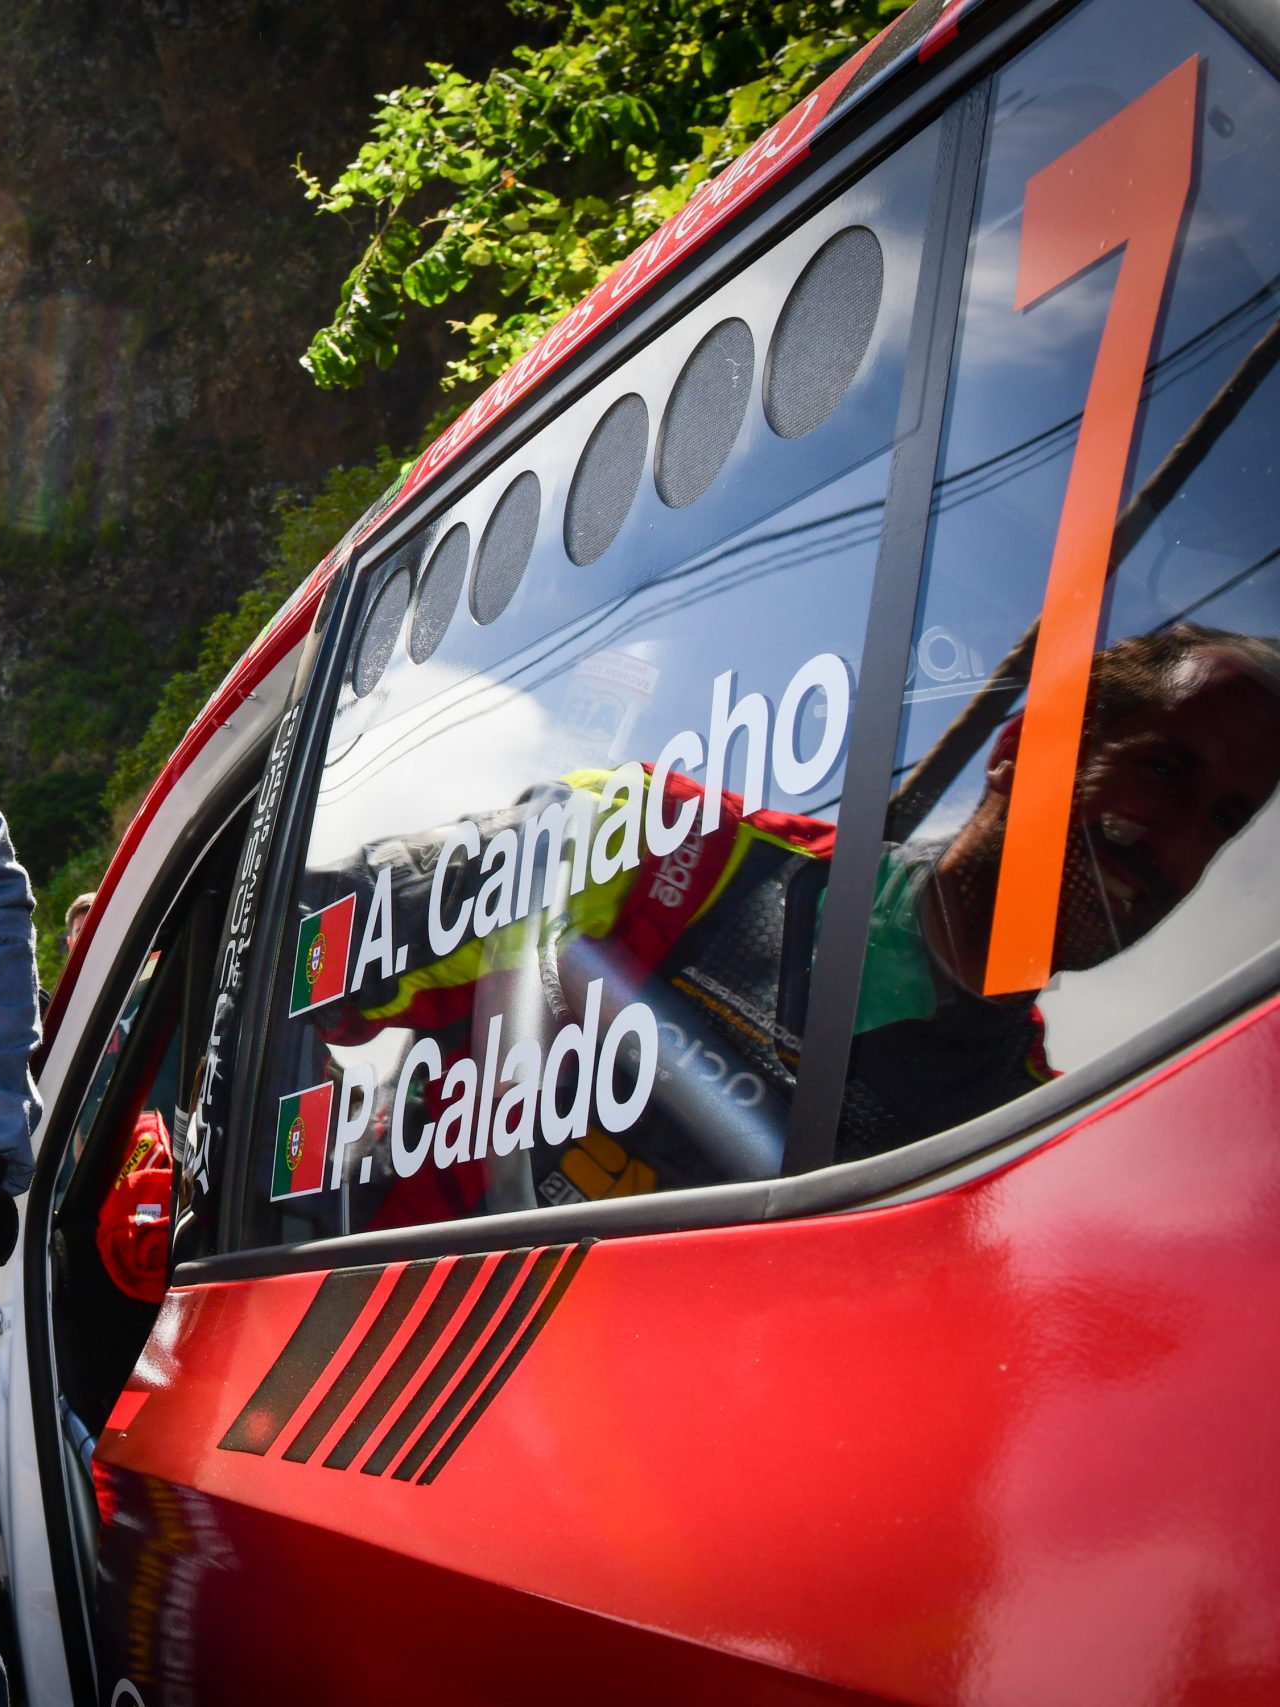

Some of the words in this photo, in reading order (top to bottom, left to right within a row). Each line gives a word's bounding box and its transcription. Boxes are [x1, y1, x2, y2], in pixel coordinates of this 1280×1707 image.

[413, 284, 606, 483] reboques
[983, 52, 1200, 997] 7
[260, 704, 299, 843] graphics
[350, 870, 408, 994] A.
[428, 652, 850, 958] Camacho
[331, 1062, 378, 1190] P.
[392, 978, 659, 1179] Calado
